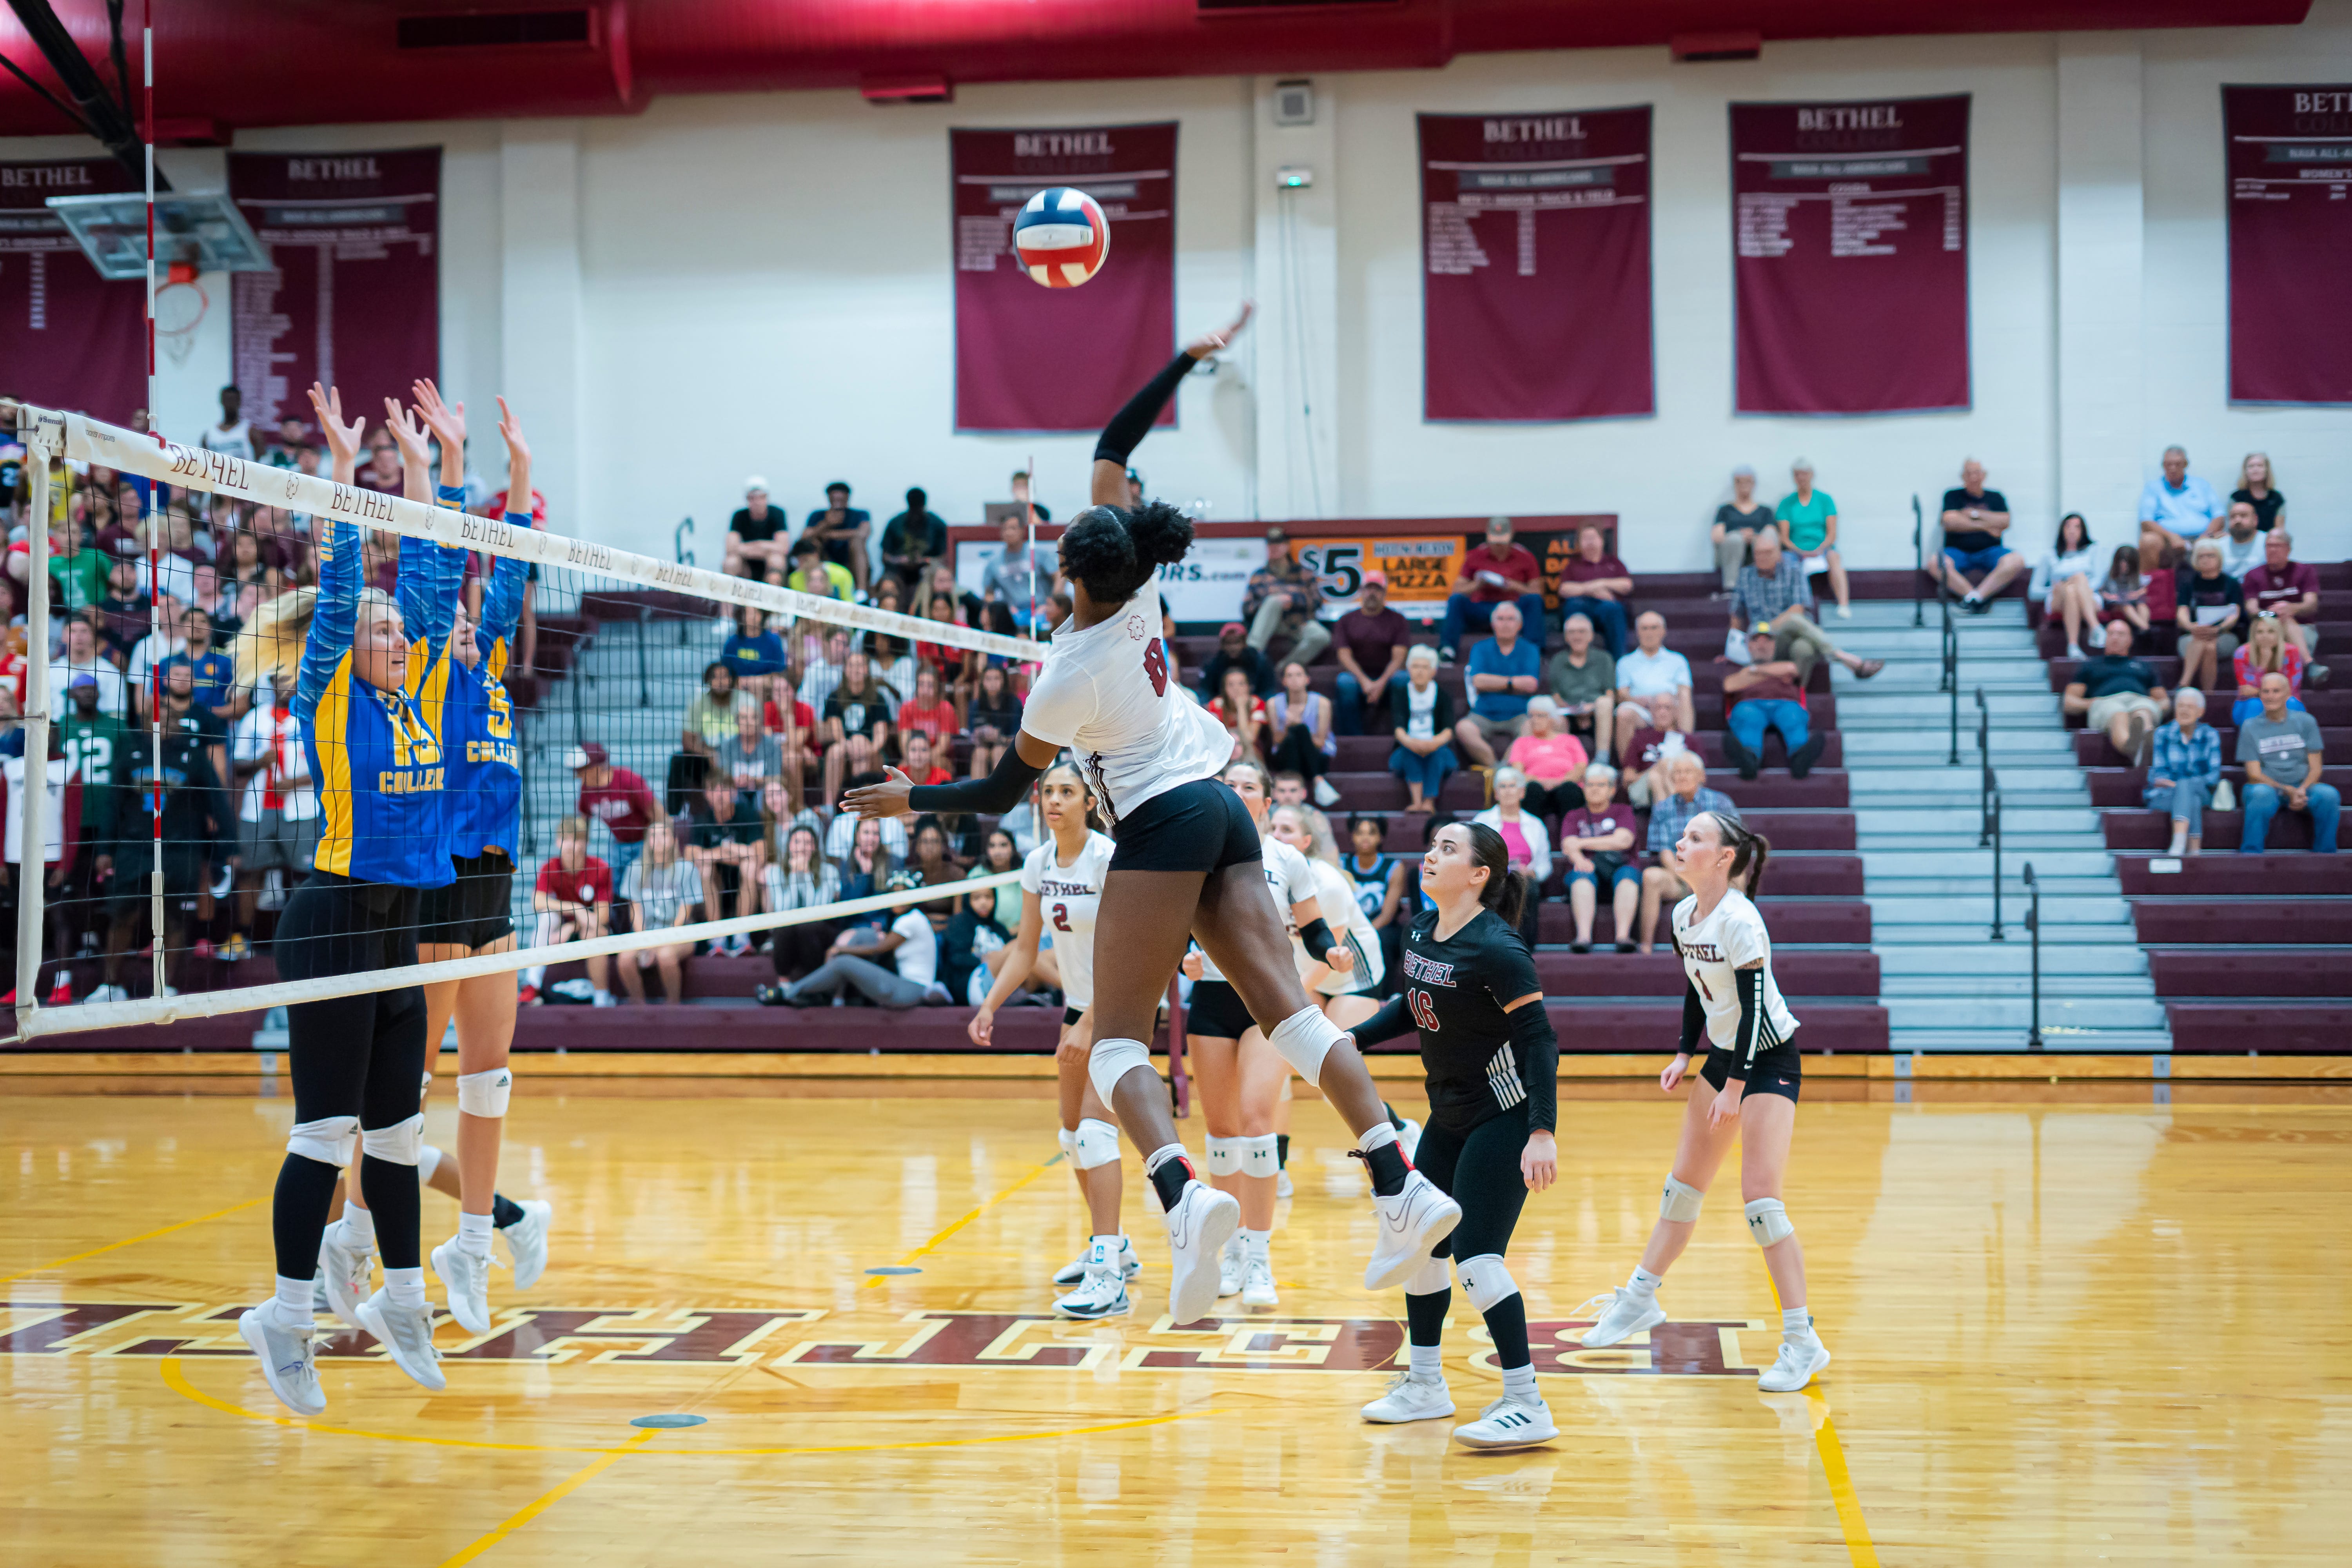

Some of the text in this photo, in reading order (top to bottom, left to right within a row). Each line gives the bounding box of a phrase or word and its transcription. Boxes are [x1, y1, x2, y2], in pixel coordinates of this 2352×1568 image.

[1797, 105, 1903, 130] BETHEL
[2295, 93, 2352, 113] BET
[1014, 132, 1114, 156] BETHEL
[1484, 117, 1588, 142] BETHEL
[2, 167, 93, 187] BETHEL
[288, 158, 381, 180] BETHEL
[168, 444, 249, 490] BETHEL
[331, 482, 395, 522] BETHEL
[461, 514, 515, 548] BETHEL
[568, 538, 612, 570] BETHEL
[1143, 637, 1167, 697] 8
[486, 686, 512, 739] 5
[387, 706, 441, 767] 15
[1052, 903, 1073, 932] 2
[1403, 949, 1457, 987] BETHEL
[1694, 969, 1713, 1002] 1
[1408, 987, 1440, 1032] 16
